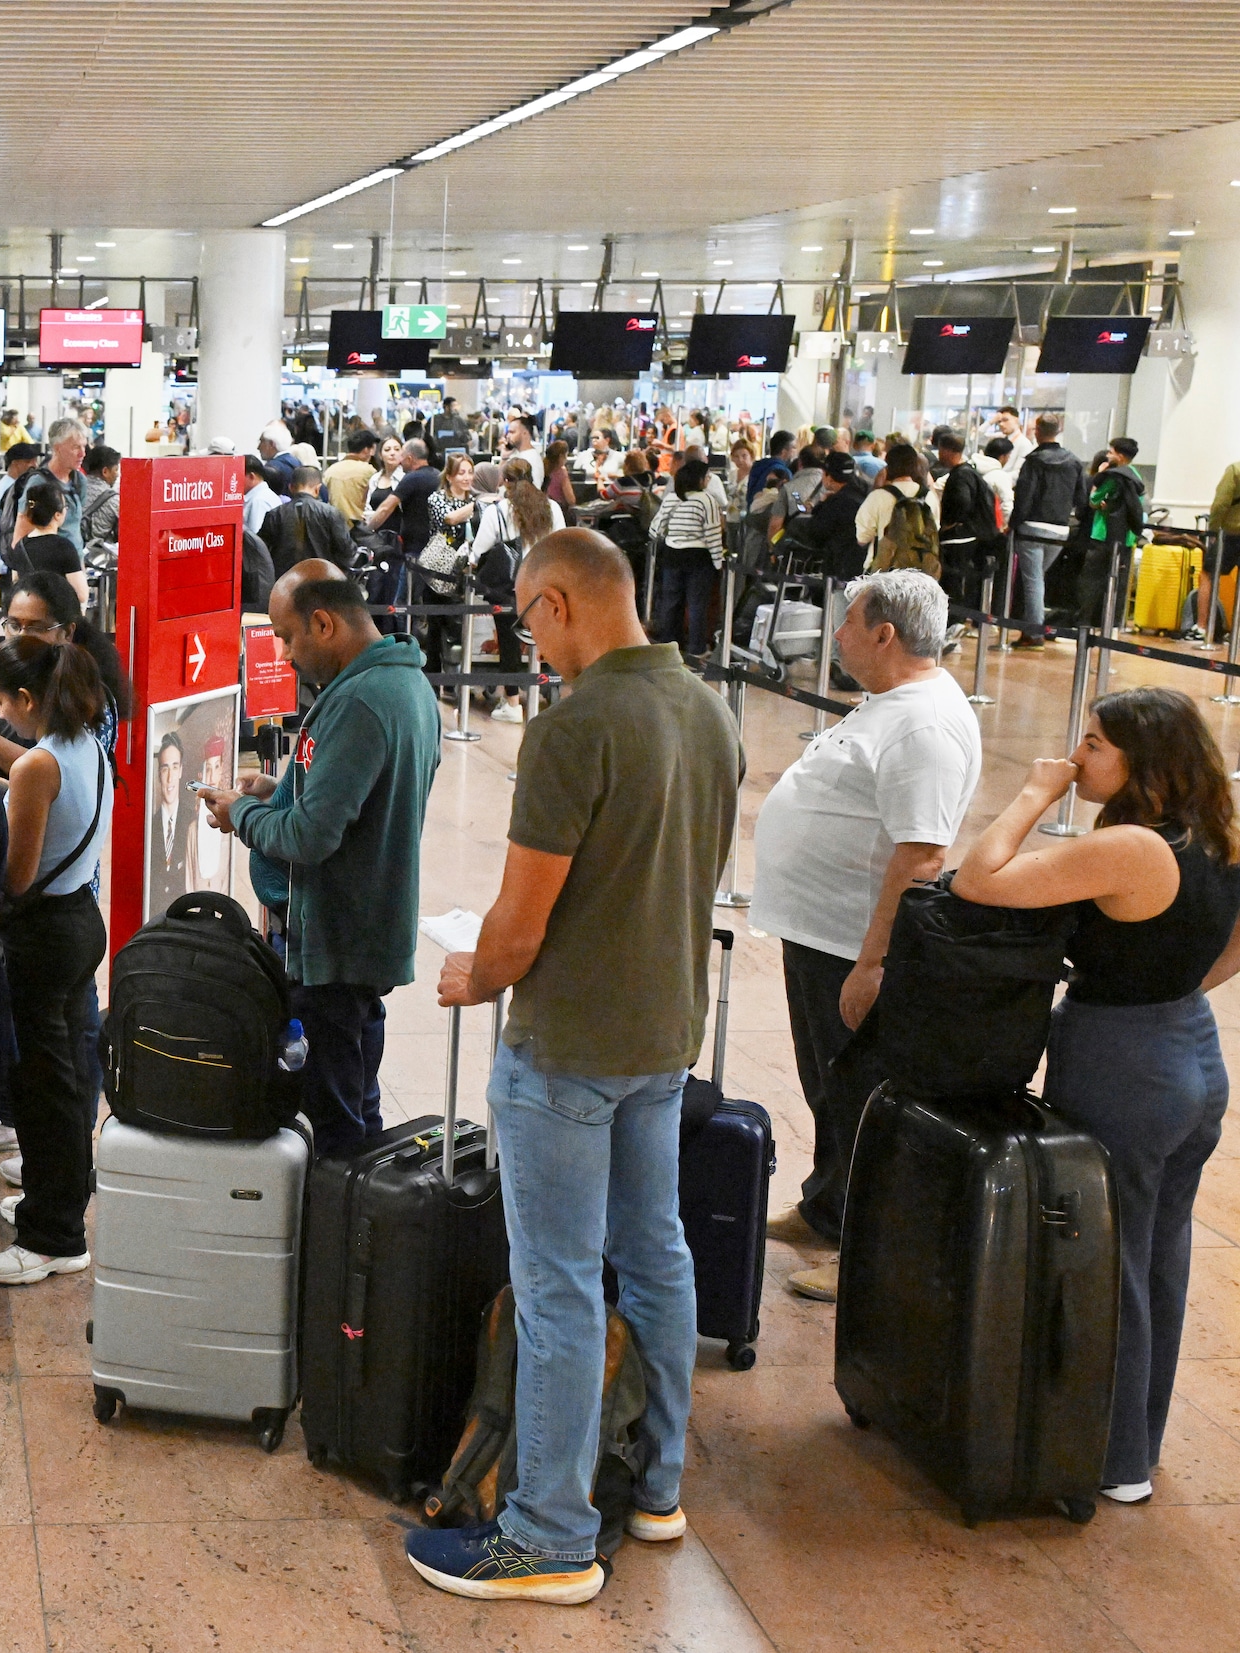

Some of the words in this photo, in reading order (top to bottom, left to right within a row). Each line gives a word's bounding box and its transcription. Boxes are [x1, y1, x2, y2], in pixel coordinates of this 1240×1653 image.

[64, 312, 103, 322] Emirates
[63, 339, 98, 349] Economy
[99, 339, 119, 348] Class
[159, 334, 185, 346] 1.6
[448, 337, 472, 348] 1.5
[506, 334, 533, 348] 1.4
[1156, 338, 1180, 351] 1.1
[163, 477, 213, 502] Emirates
[224, 491, 243, 501] Emirates
[168, 535, 204, 553] Economy
[206, 532, 224, 549] Class
